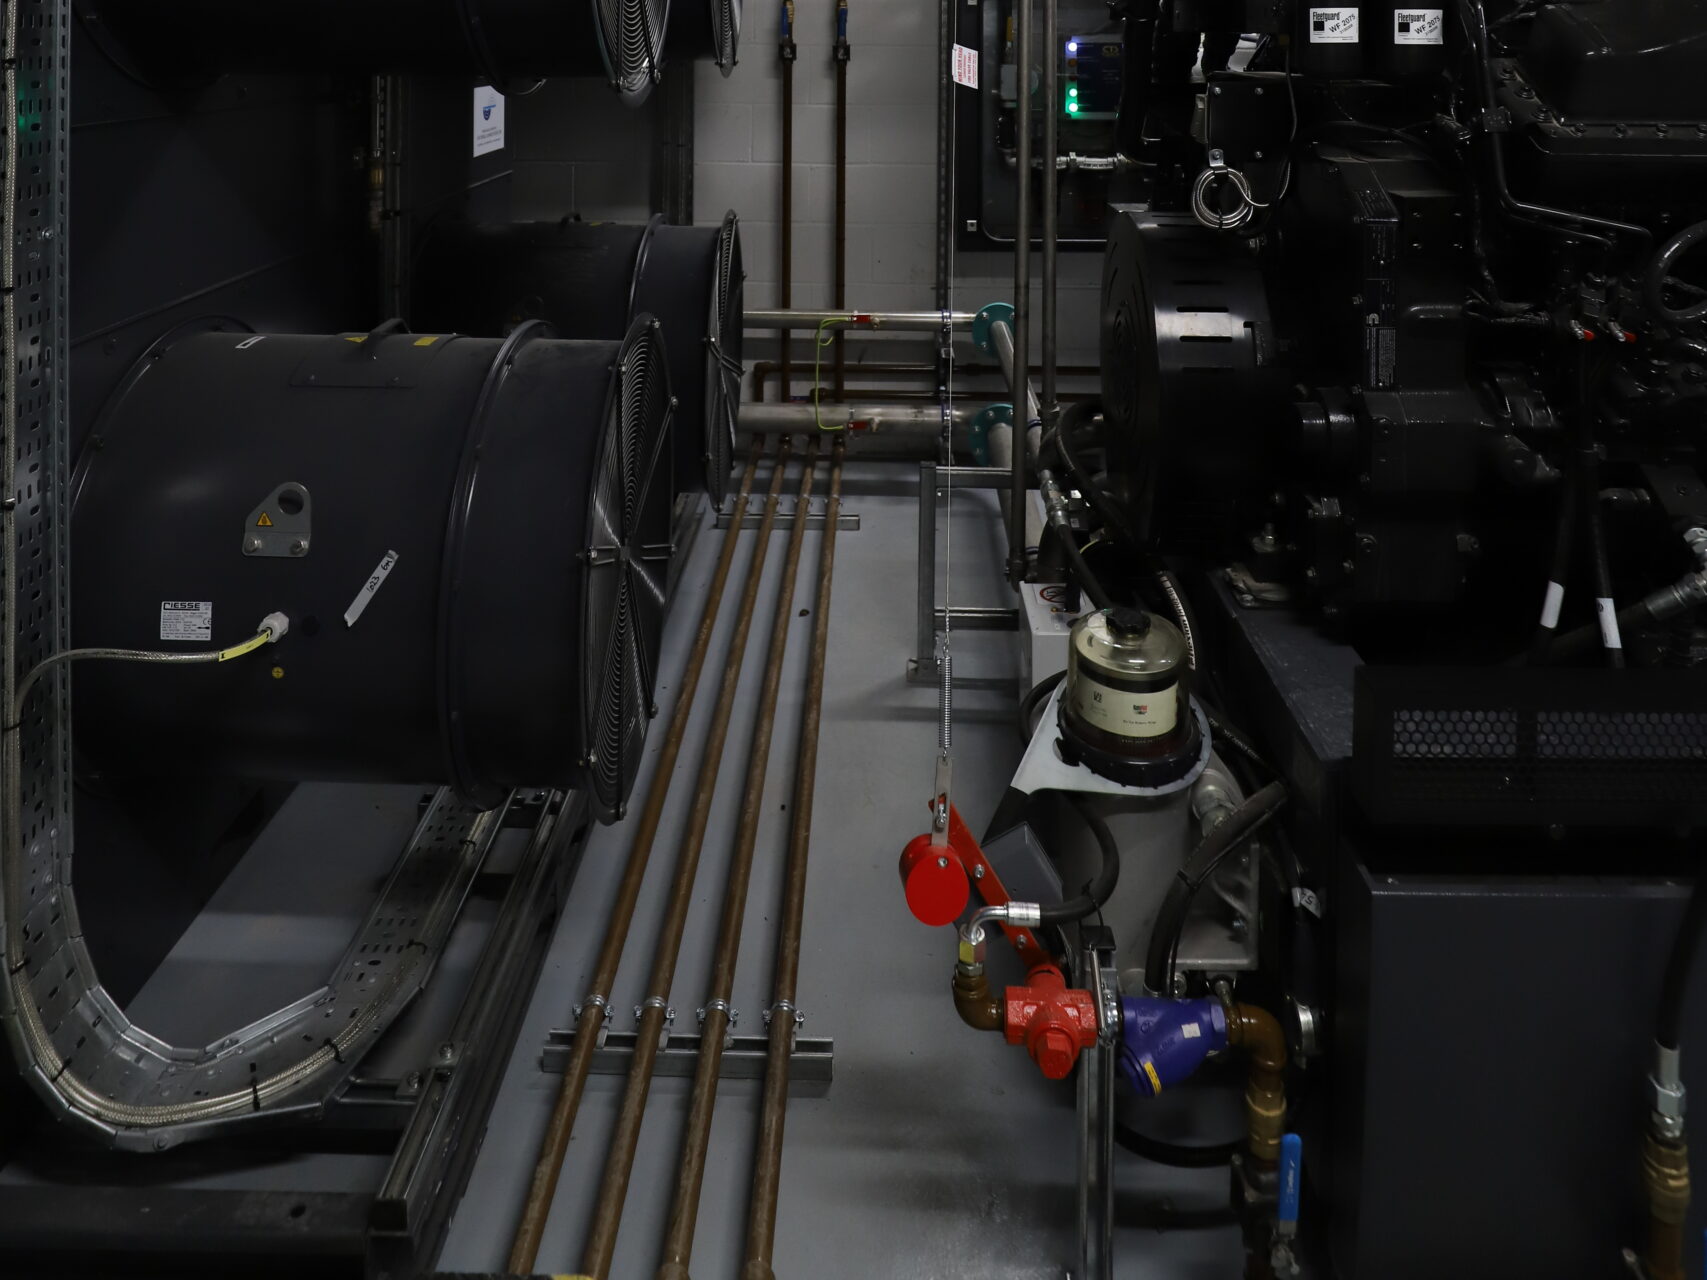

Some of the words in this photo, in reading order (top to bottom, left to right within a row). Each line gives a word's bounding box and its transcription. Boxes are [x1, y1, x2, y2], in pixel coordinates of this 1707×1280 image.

[1312, 11, 1341, 22] Fleetguard
[1329, 23, 1341, 33] WF
[1341, 13, 1356, 26] 2075
[1397, 12, 1426, 23] Fleetguard
[1414, 24, 1427, 35] WF
[1427, 15, 1441, 28] 2075
